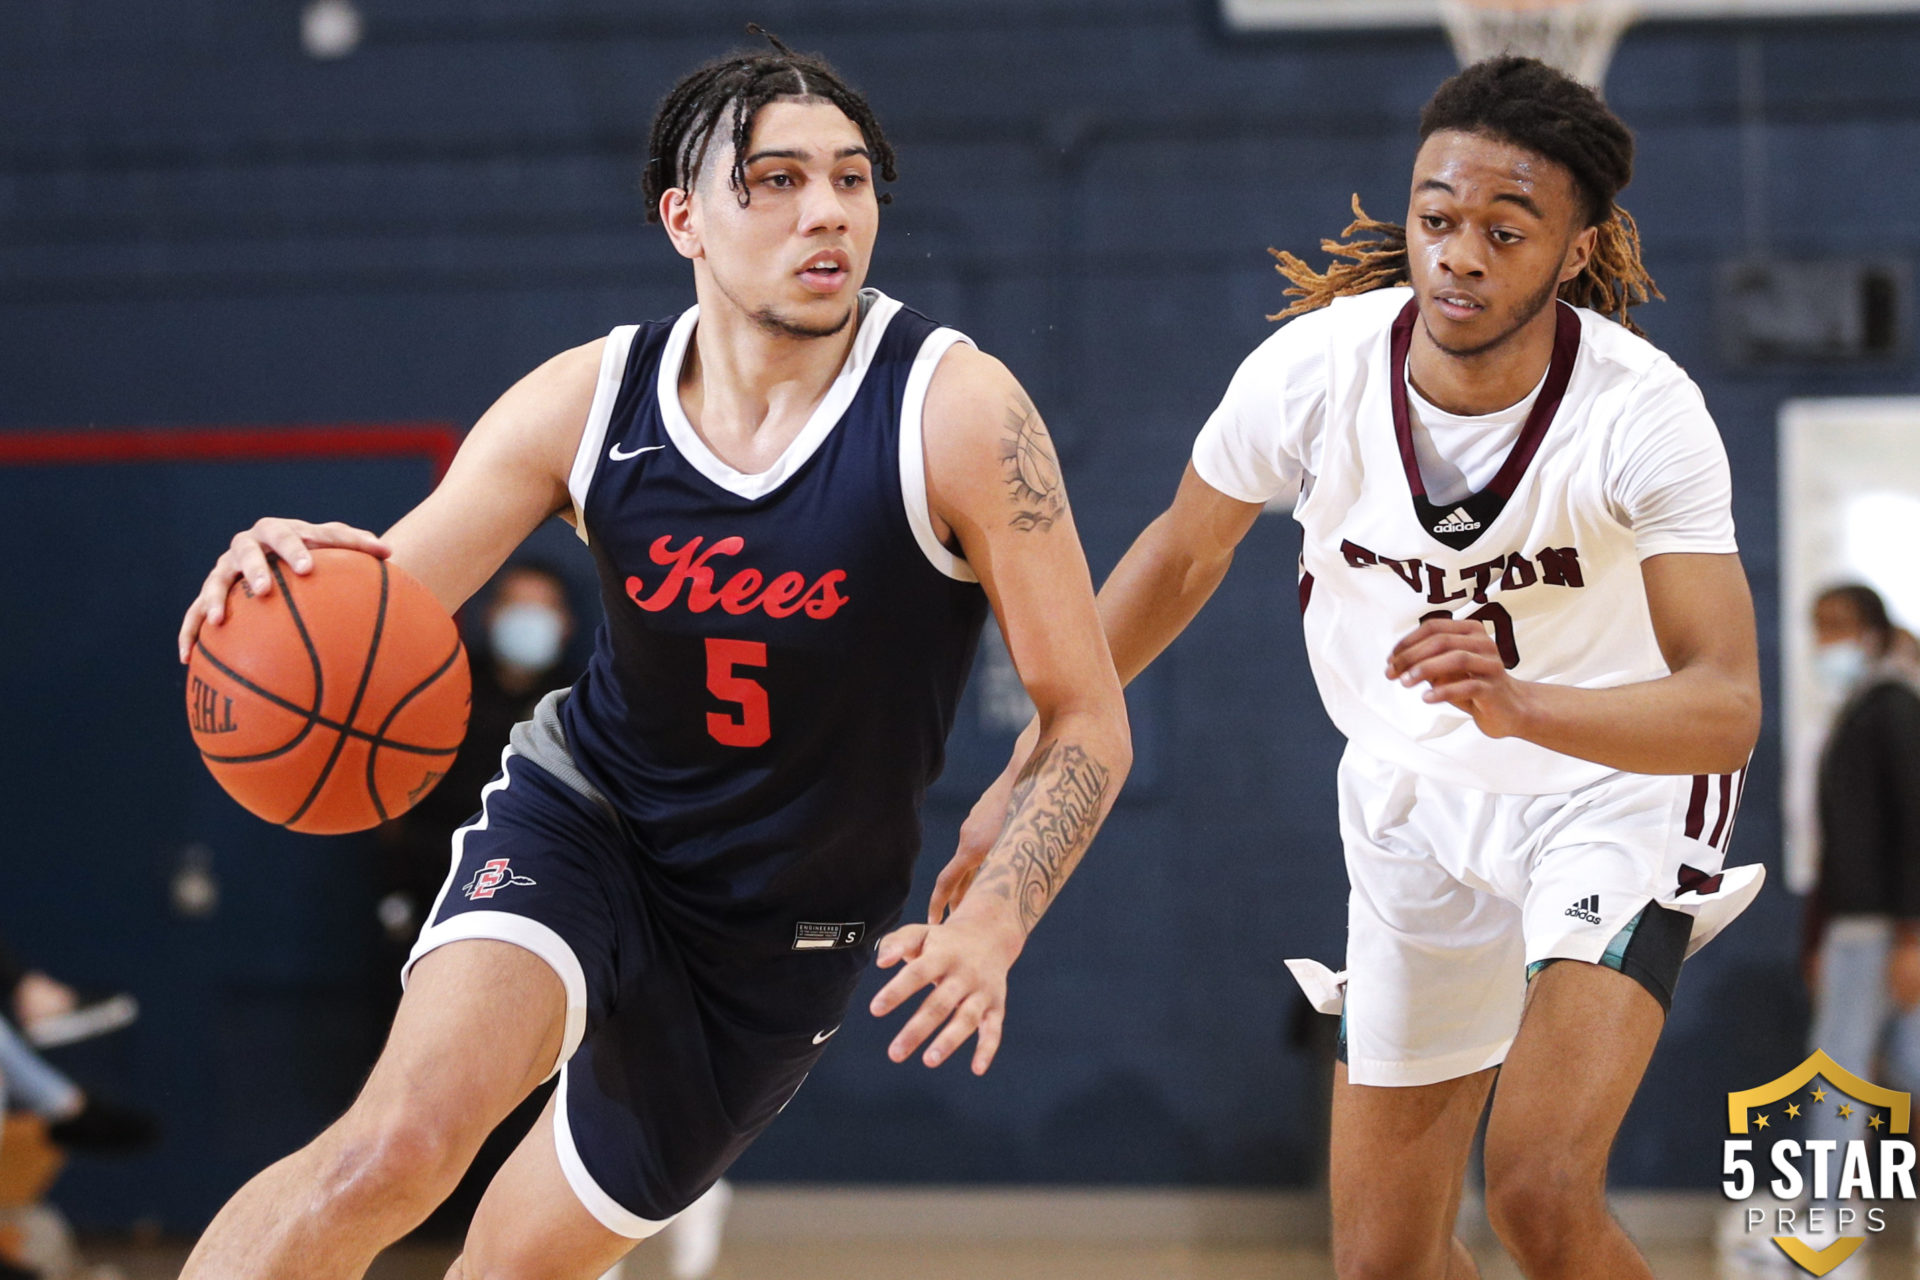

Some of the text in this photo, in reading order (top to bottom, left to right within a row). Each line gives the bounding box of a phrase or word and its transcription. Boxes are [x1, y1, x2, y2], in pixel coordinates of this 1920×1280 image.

[1433, 520, 1481, 534] adidas
[625, 534, 850, 620] Kees
[704, 637, 771, 747] 5
[1019, 762, 1110, 930] Serenity
[845, 931, 856, 943] S
[1564, 908, 1602, 925] adidas
